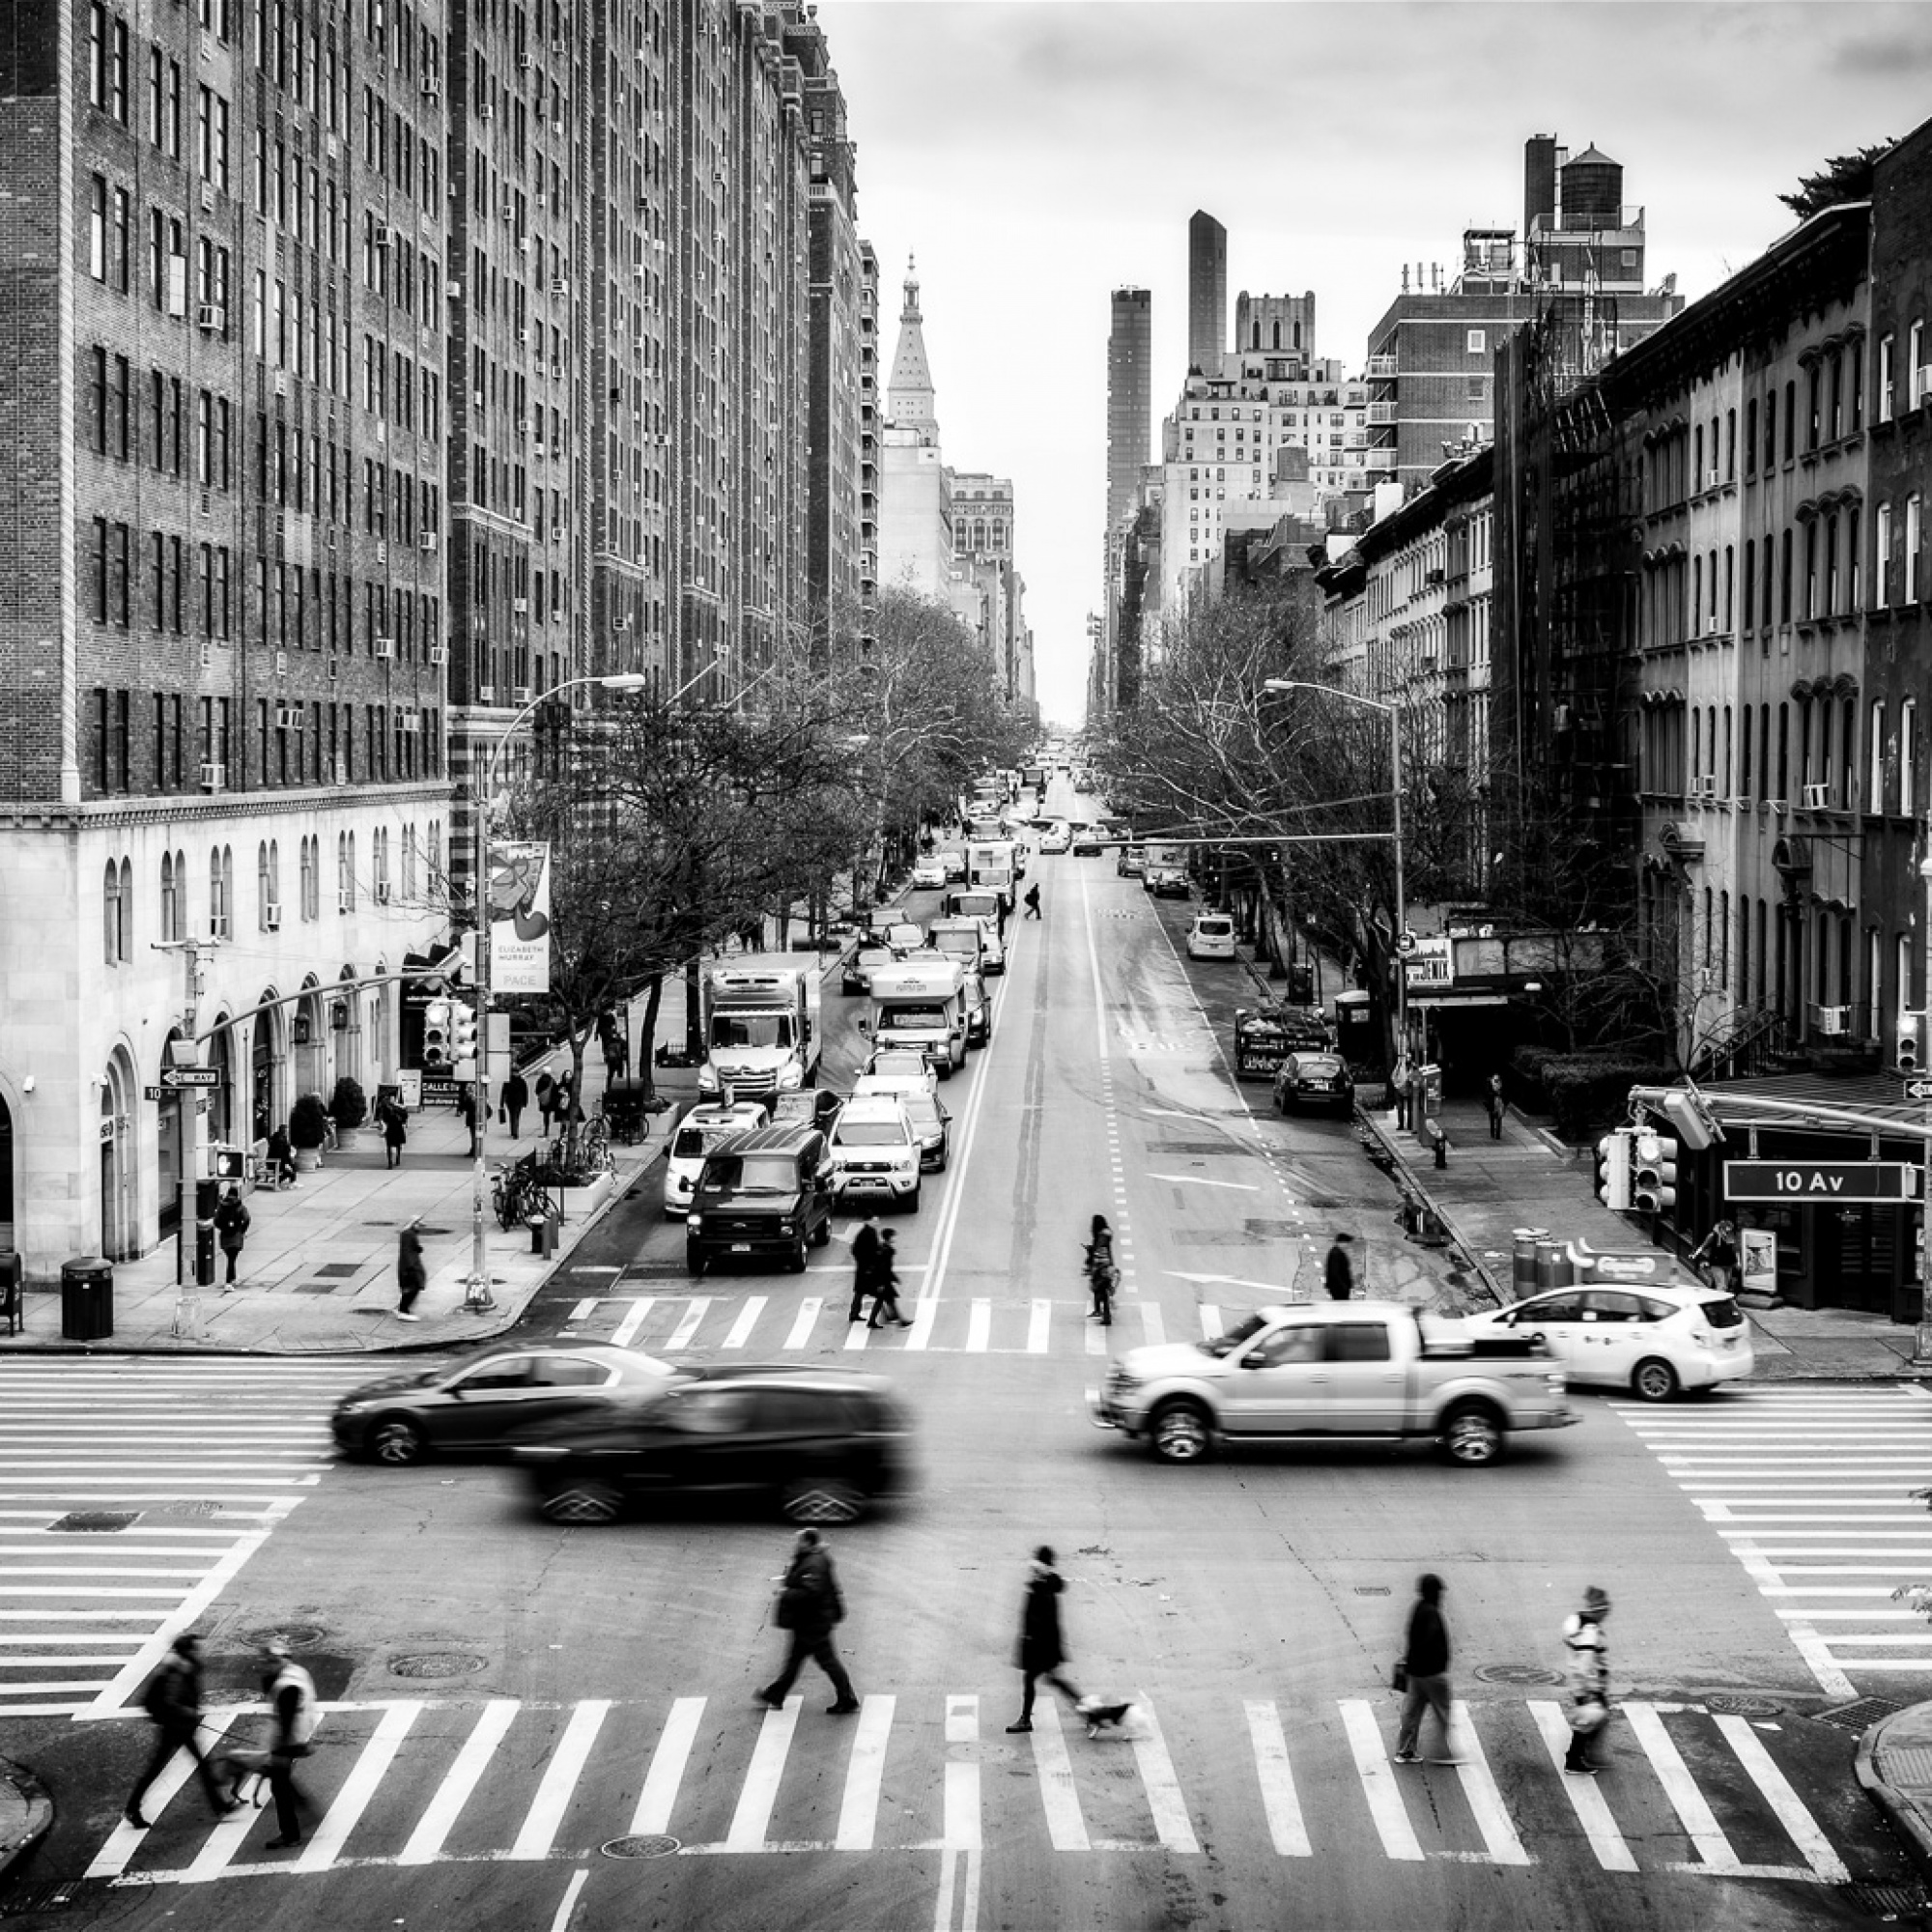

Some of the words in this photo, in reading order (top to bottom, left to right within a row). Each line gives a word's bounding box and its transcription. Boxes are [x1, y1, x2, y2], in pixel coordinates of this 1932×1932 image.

[503, 975, 536, 985] PACE
[149, 1088, 160, 1099] 10
[1776, 1171, 1803, 1191] 10
[1809, 1171, 1844, 1191] Av
